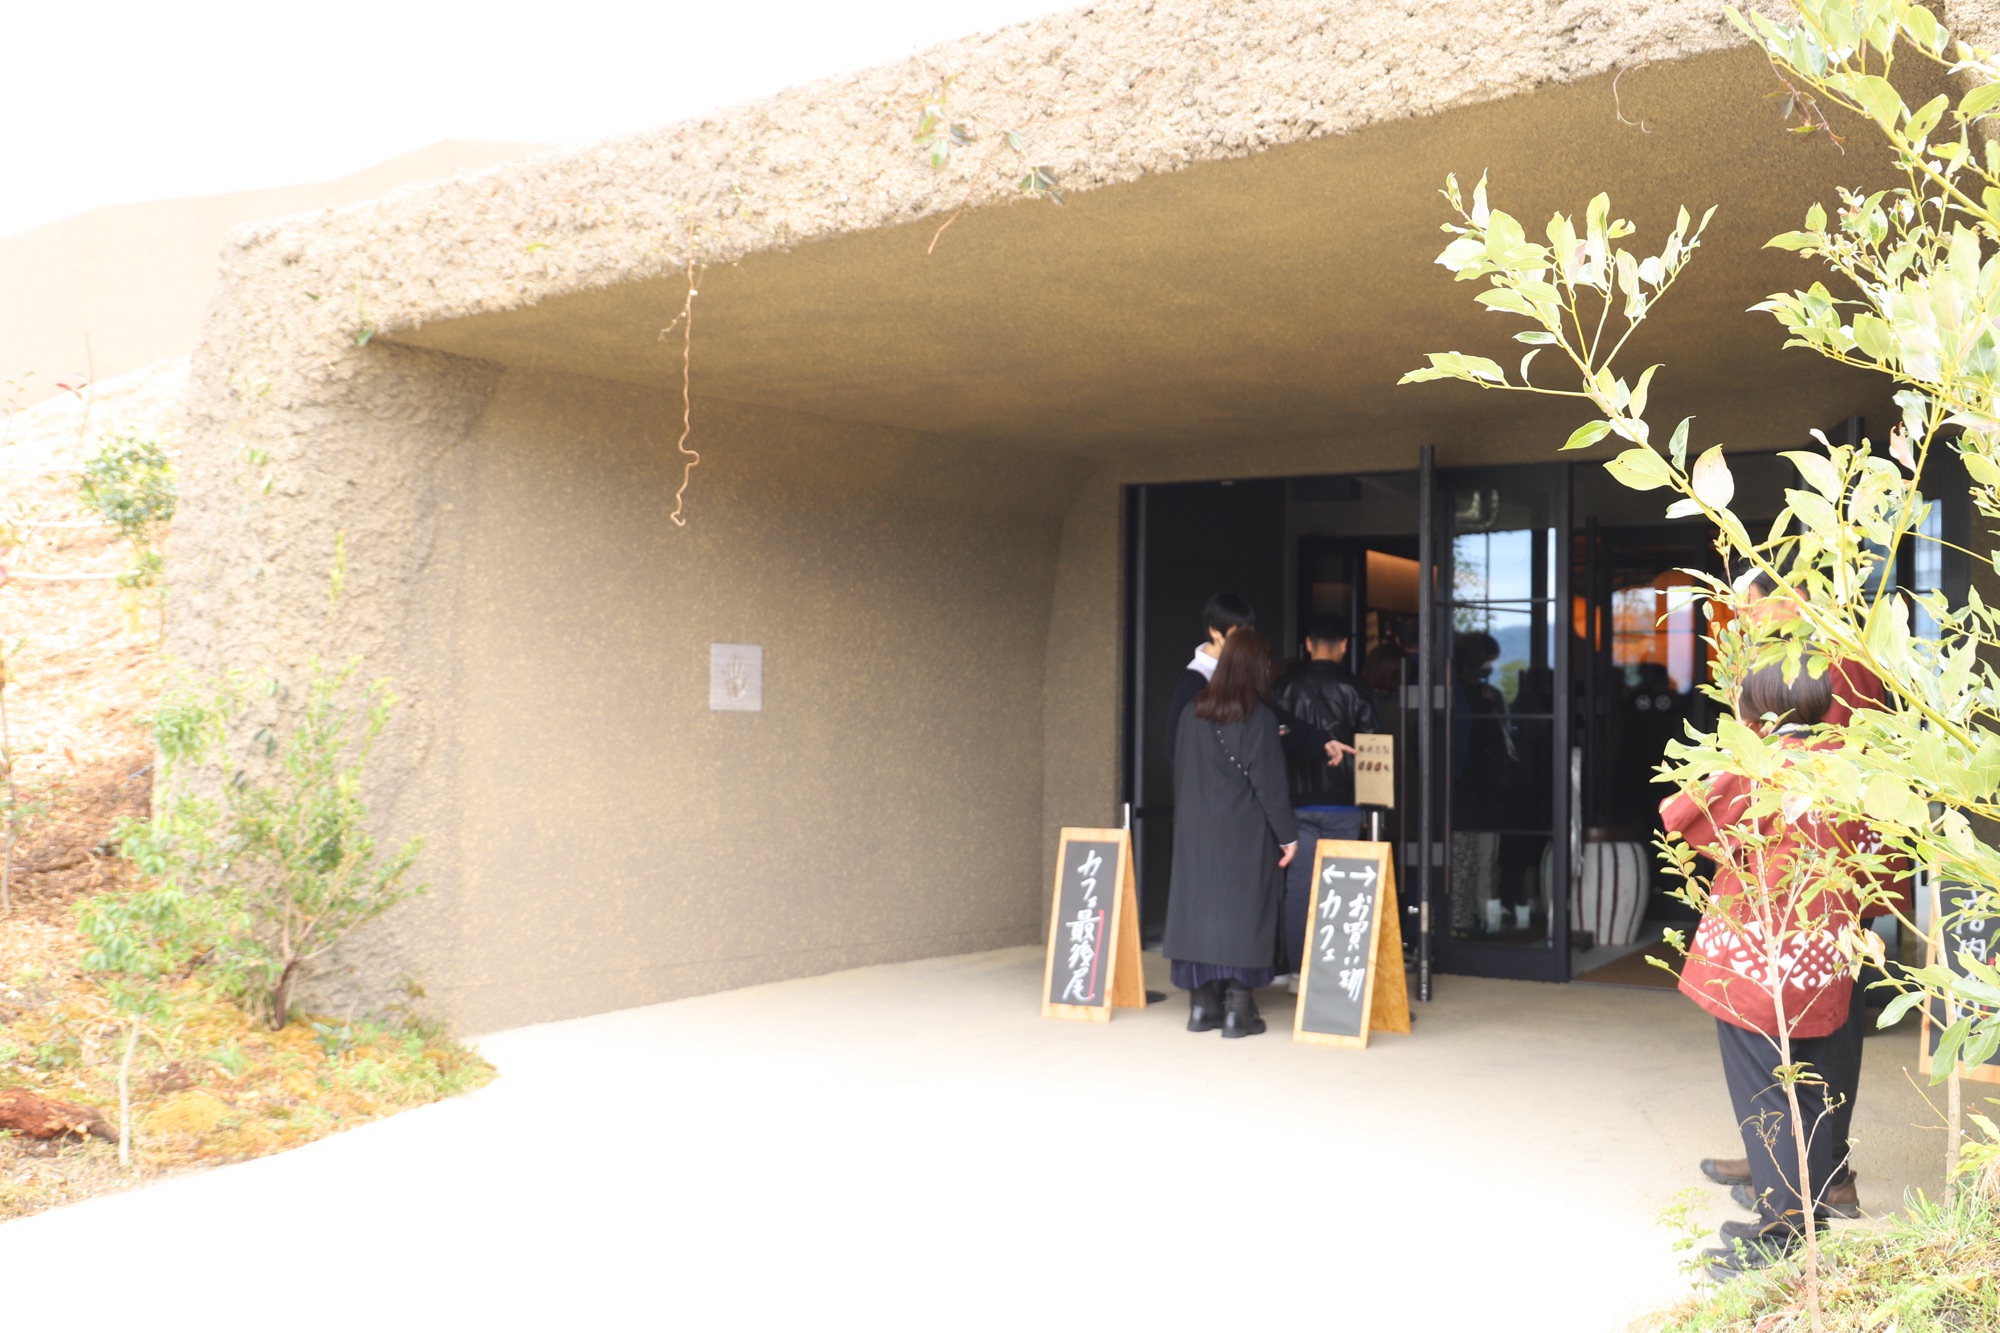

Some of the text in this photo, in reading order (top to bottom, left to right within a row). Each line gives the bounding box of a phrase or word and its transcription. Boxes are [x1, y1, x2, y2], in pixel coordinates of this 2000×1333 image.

[1063, 849, 1102, 1001] カフェ最後尾
[1319, 889, 1342, 962] カフェ
[1339, 892, 1373, 1002] お買い物
